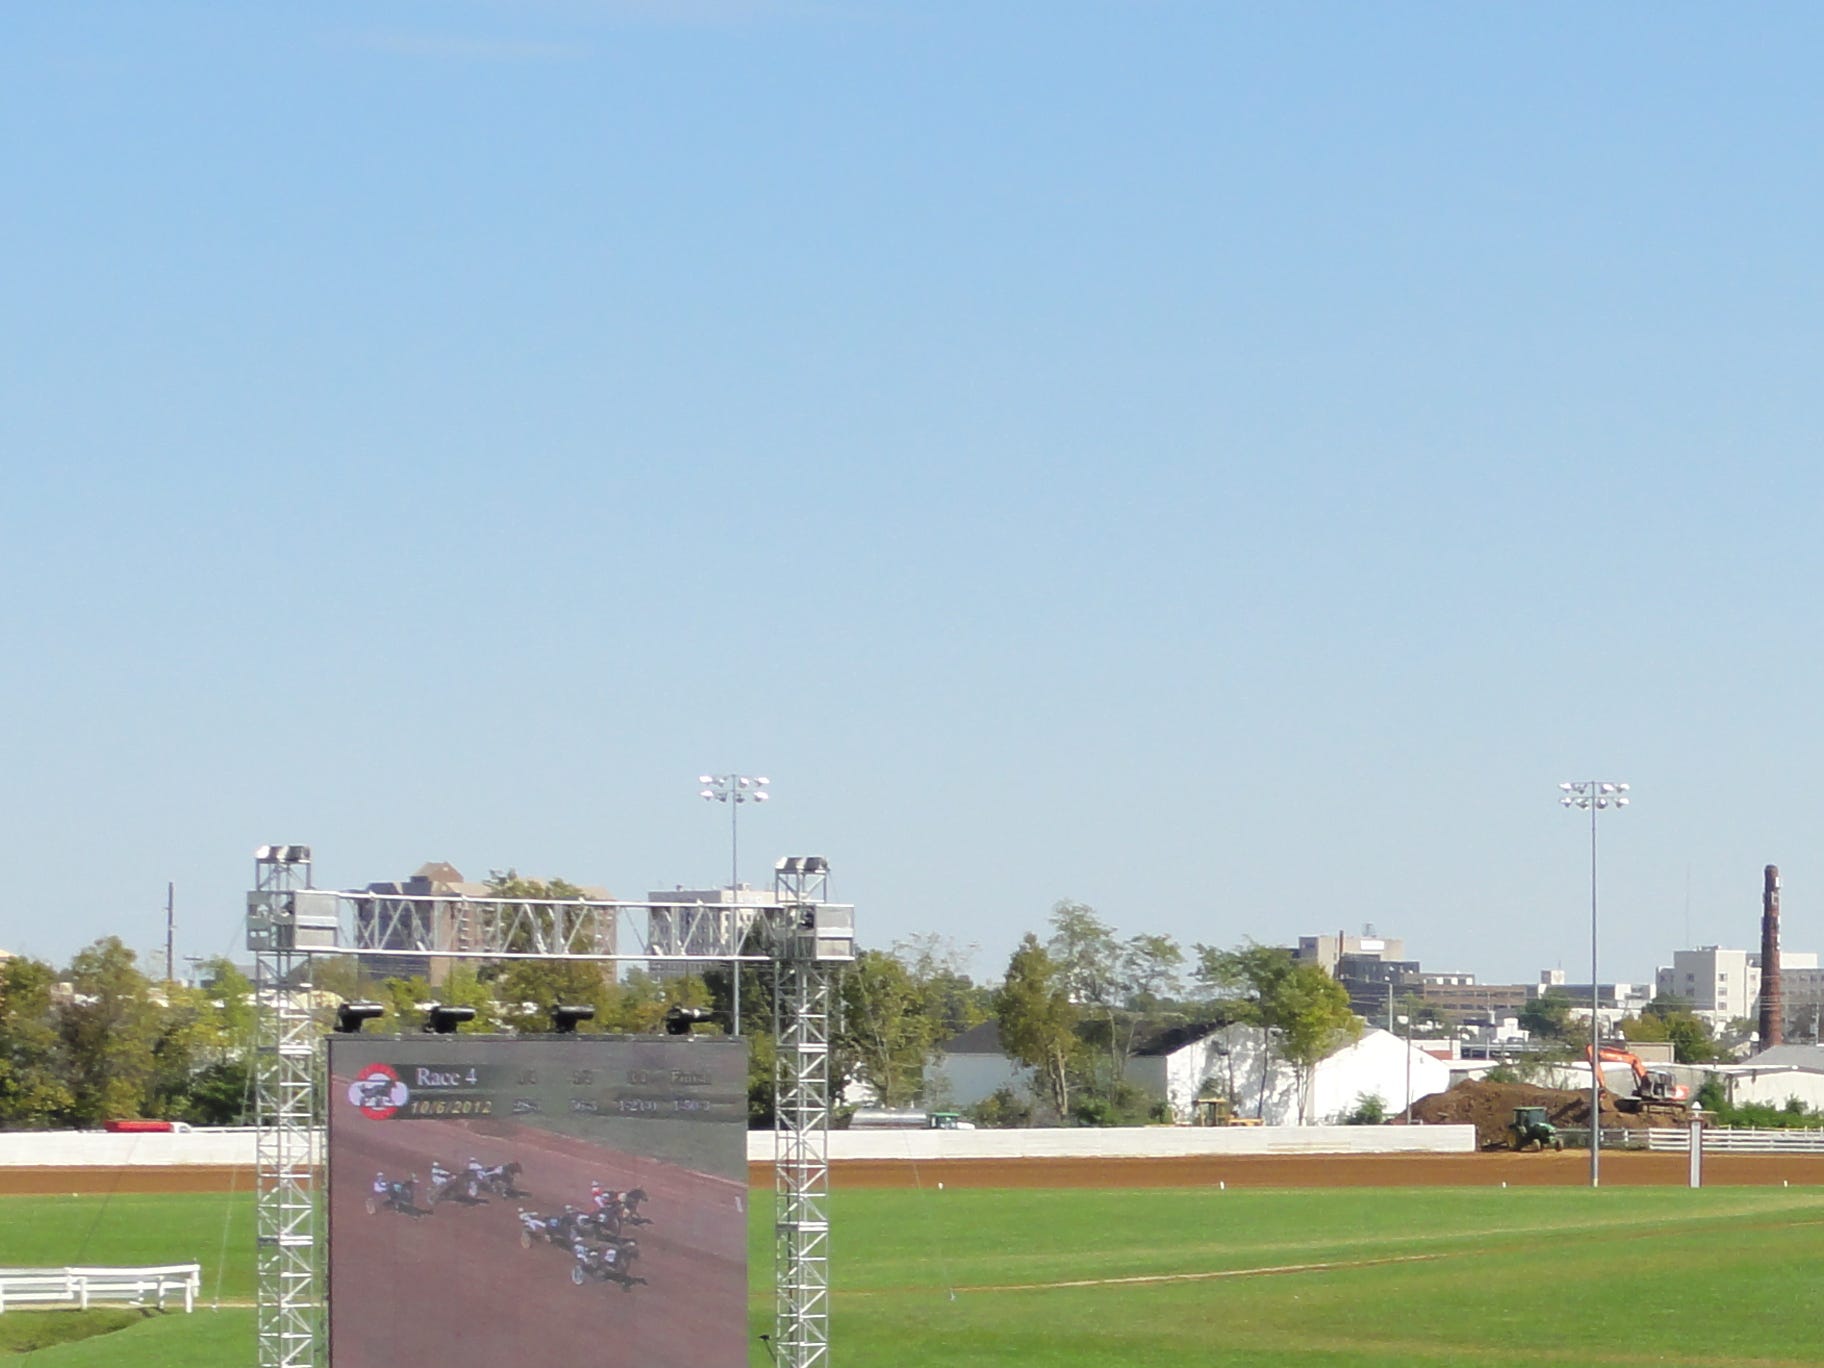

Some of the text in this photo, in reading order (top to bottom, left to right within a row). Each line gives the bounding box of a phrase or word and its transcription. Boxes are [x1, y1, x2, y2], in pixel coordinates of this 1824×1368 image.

[415, 1067, 479, 1086] Race 4
[411, 1100, 493, 1114] 10/6/2012
